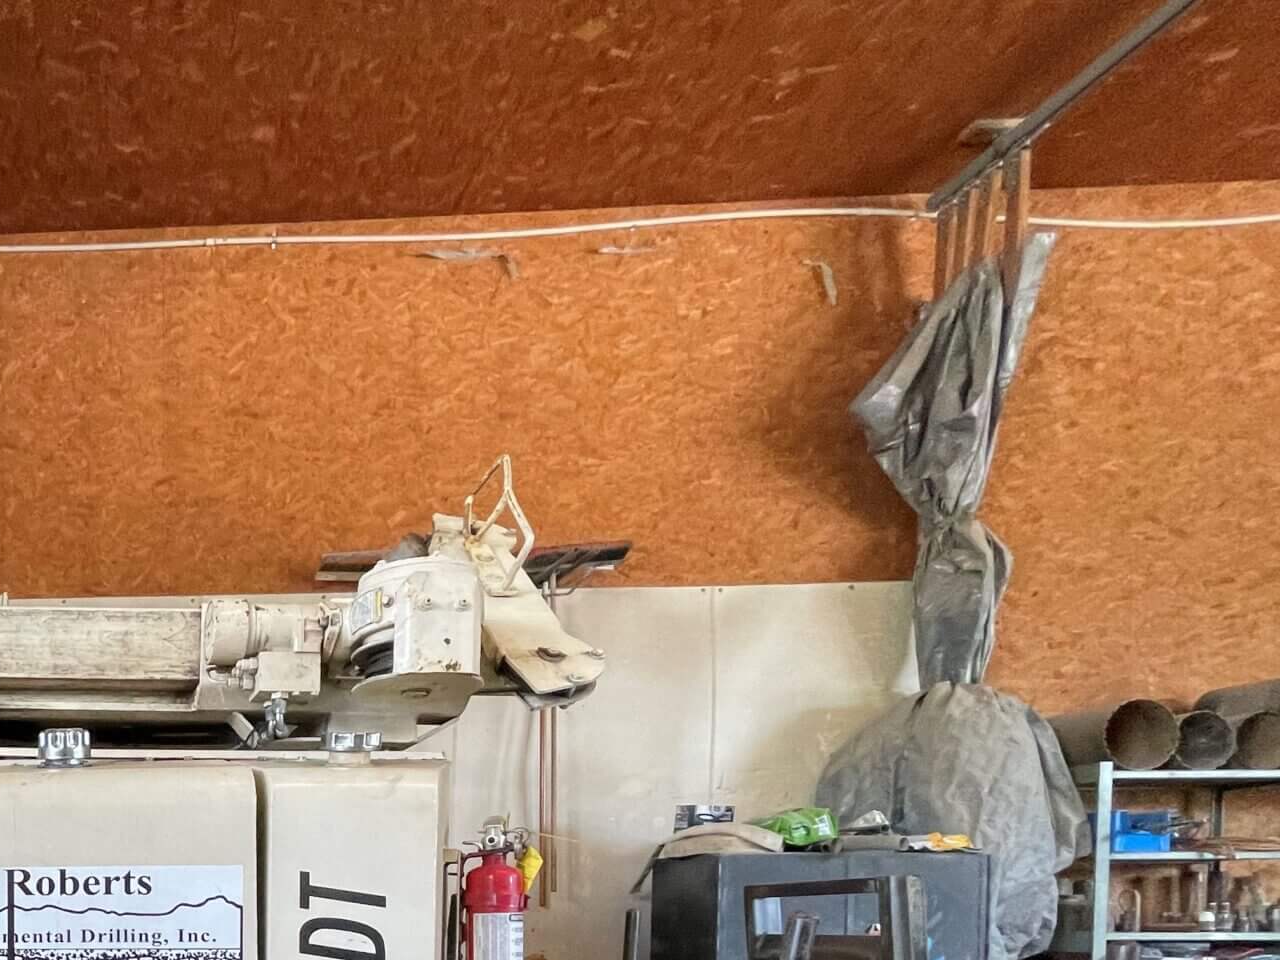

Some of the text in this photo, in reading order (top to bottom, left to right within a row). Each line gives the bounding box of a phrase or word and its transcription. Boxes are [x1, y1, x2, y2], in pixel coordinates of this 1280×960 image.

[6, 869, 152, 896] Roberts
[81, 929, 169, 946] Drilling,
[177, 929, 217, 943] Inc.
